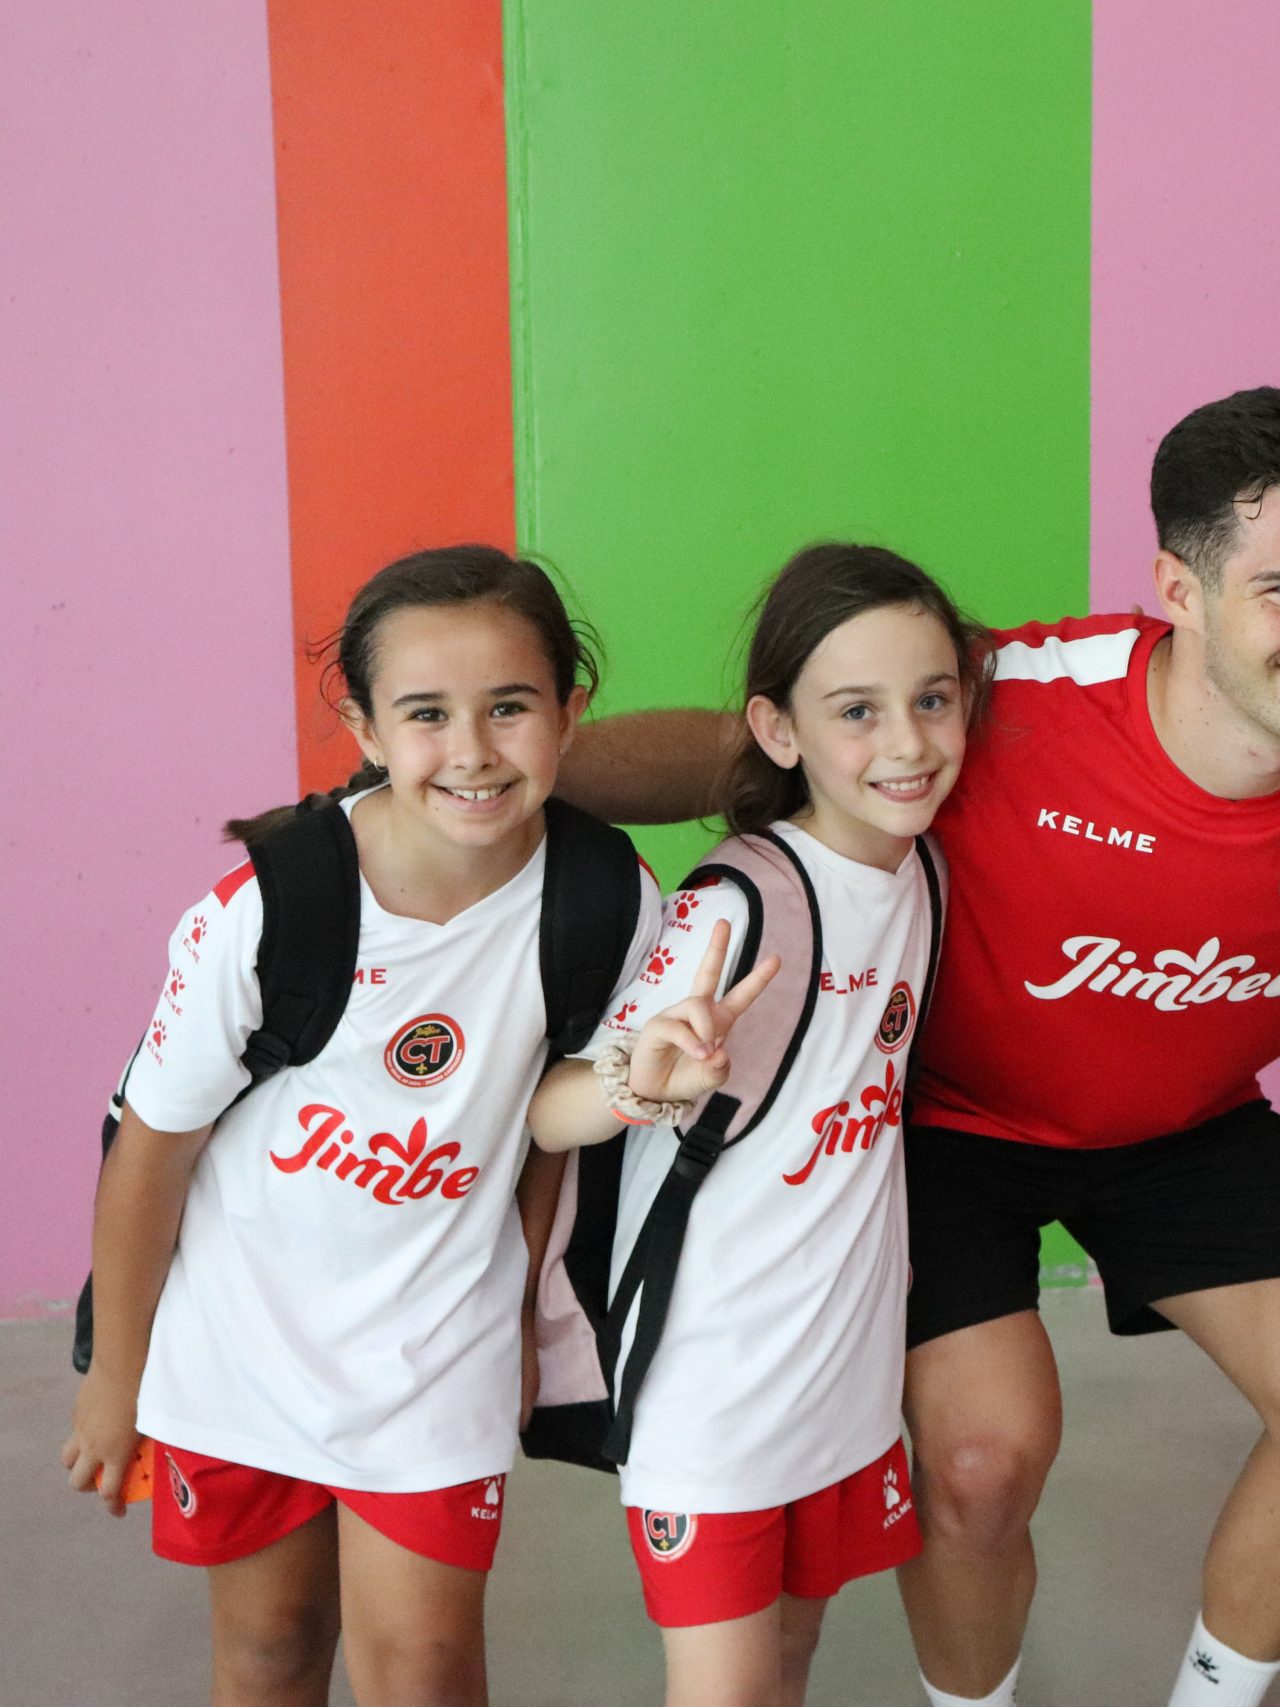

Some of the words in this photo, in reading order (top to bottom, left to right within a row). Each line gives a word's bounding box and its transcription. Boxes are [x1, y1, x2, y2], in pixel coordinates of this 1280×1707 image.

[1036, 808, 1157, 854] KELME
[881, 1003, 907, 1032] CT
[399, 1035, 451, 1065] CT
[647, 1511, 684, 1541] CT
